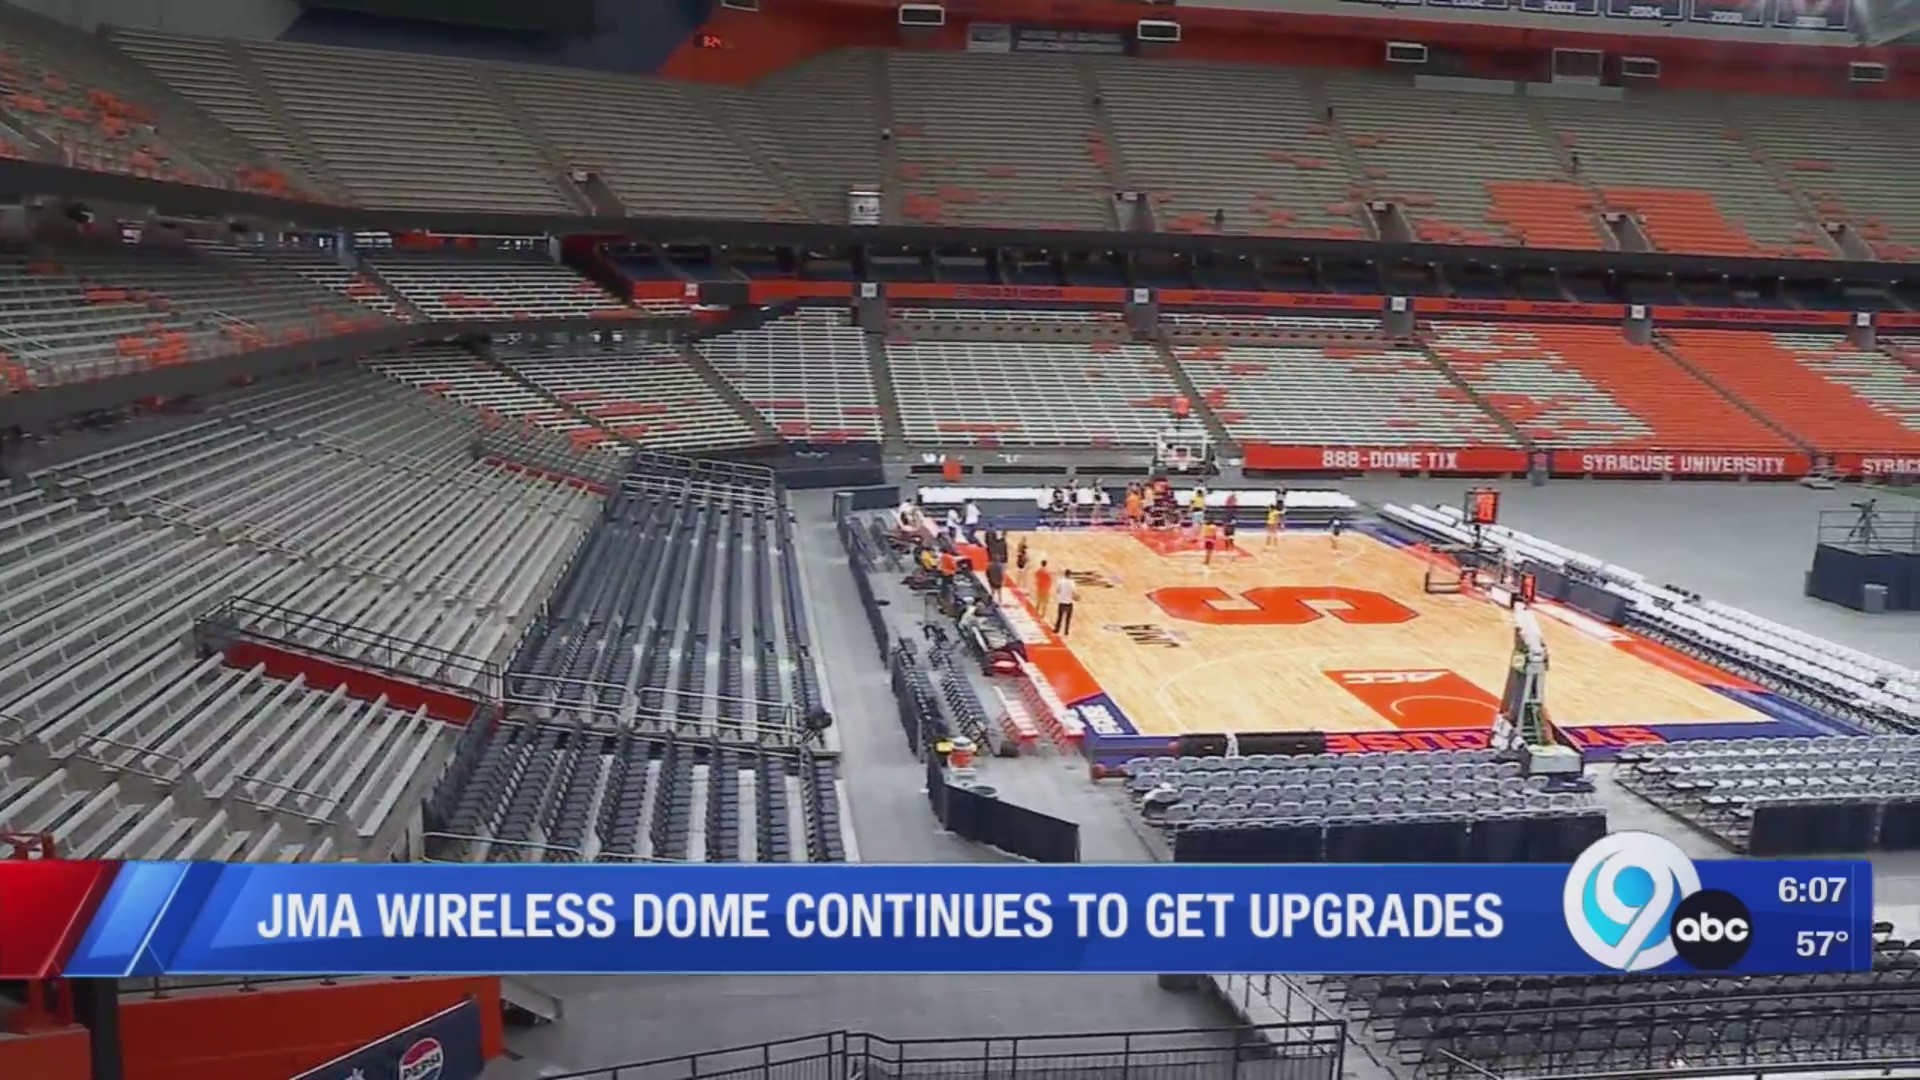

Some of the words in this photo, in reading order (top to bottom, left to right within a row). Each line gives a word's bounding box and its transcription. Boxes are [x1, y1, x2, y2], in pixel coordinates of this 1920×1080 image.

[1322, 450, 1422, 469] 888-DOME
[1425, 451, 1458, 469] TIX
[1582, 454, 1675, 472] SYRACUSE
[1680, 455, 1785, 474] UNIVERSITY
